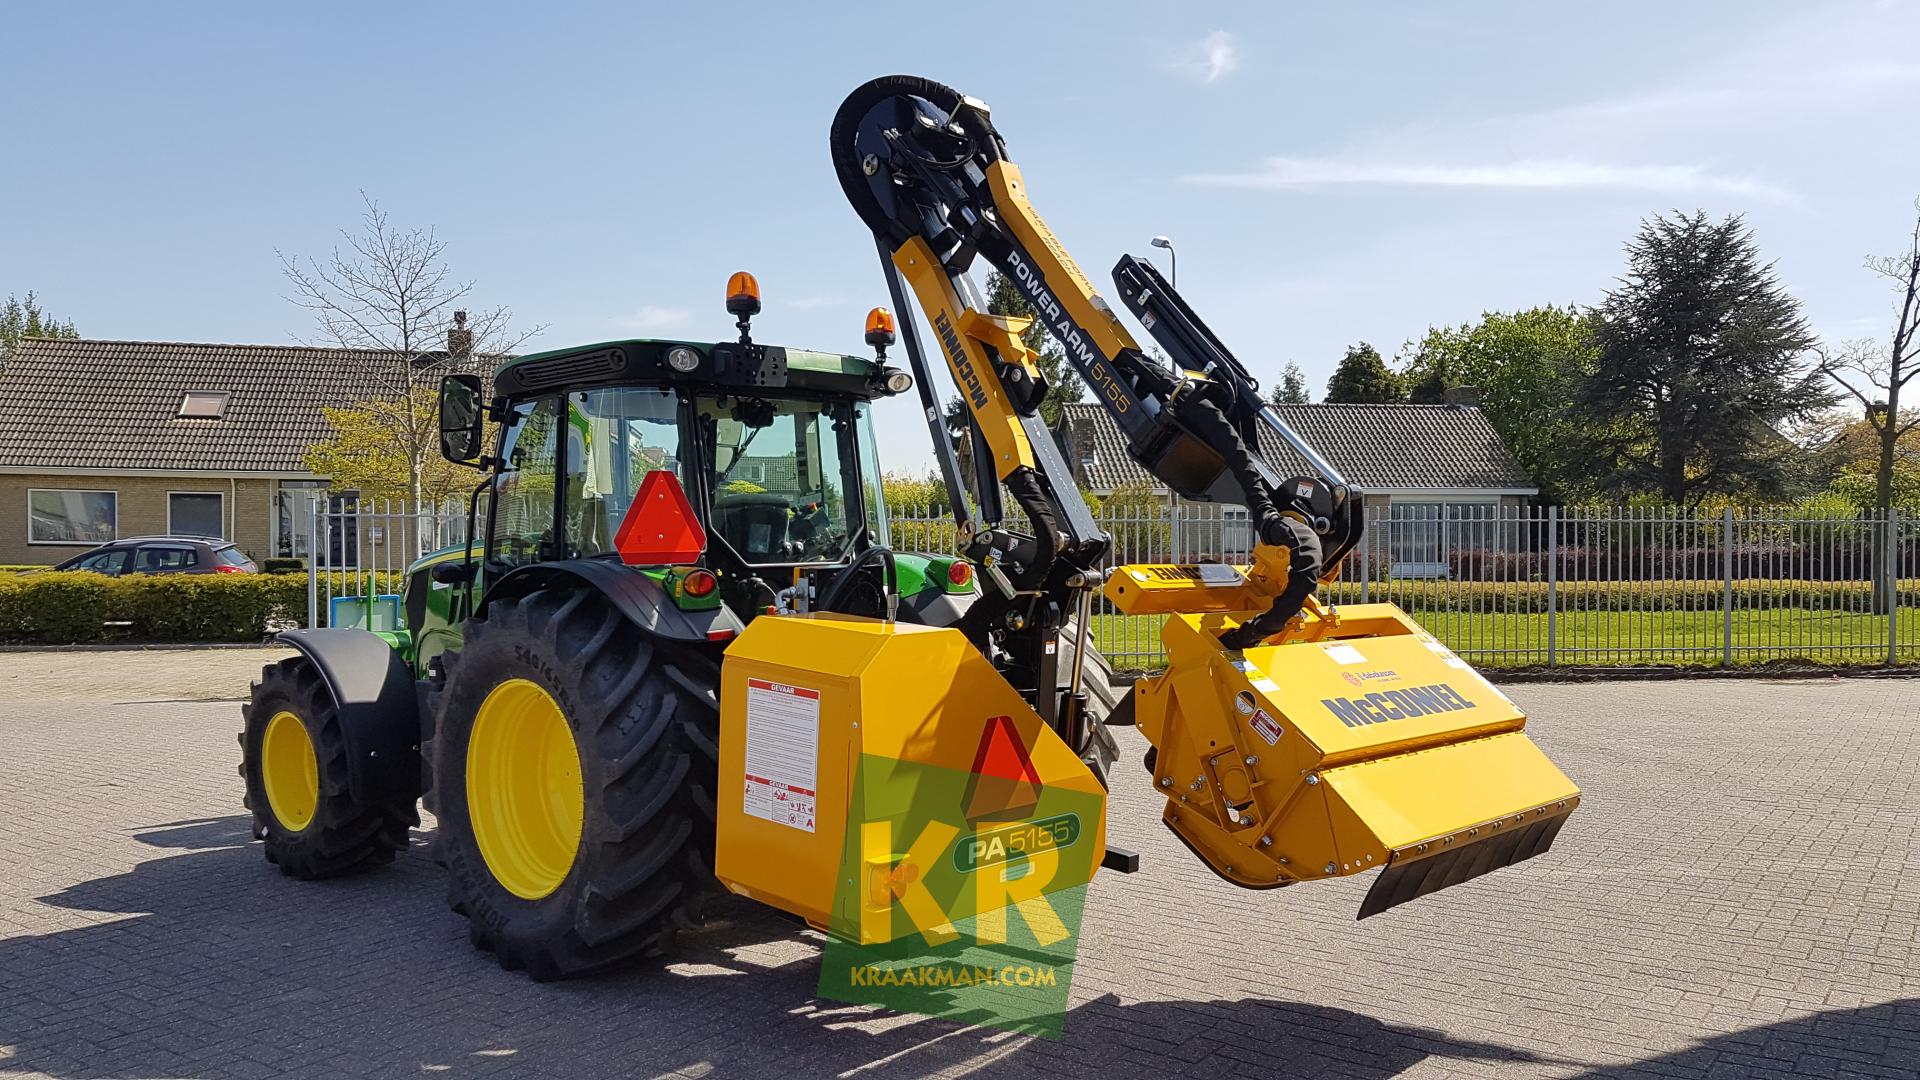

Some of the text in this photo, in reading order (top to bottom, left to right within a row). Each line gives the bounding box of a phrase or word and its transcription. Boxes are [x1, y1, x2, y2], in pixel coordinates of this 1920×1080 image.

[1007, 250, 1131, 414] POWER ARM 5155
[771, 684, 795, 695] GEVAAR
[968, 820, 1070, 864] PA 5155
